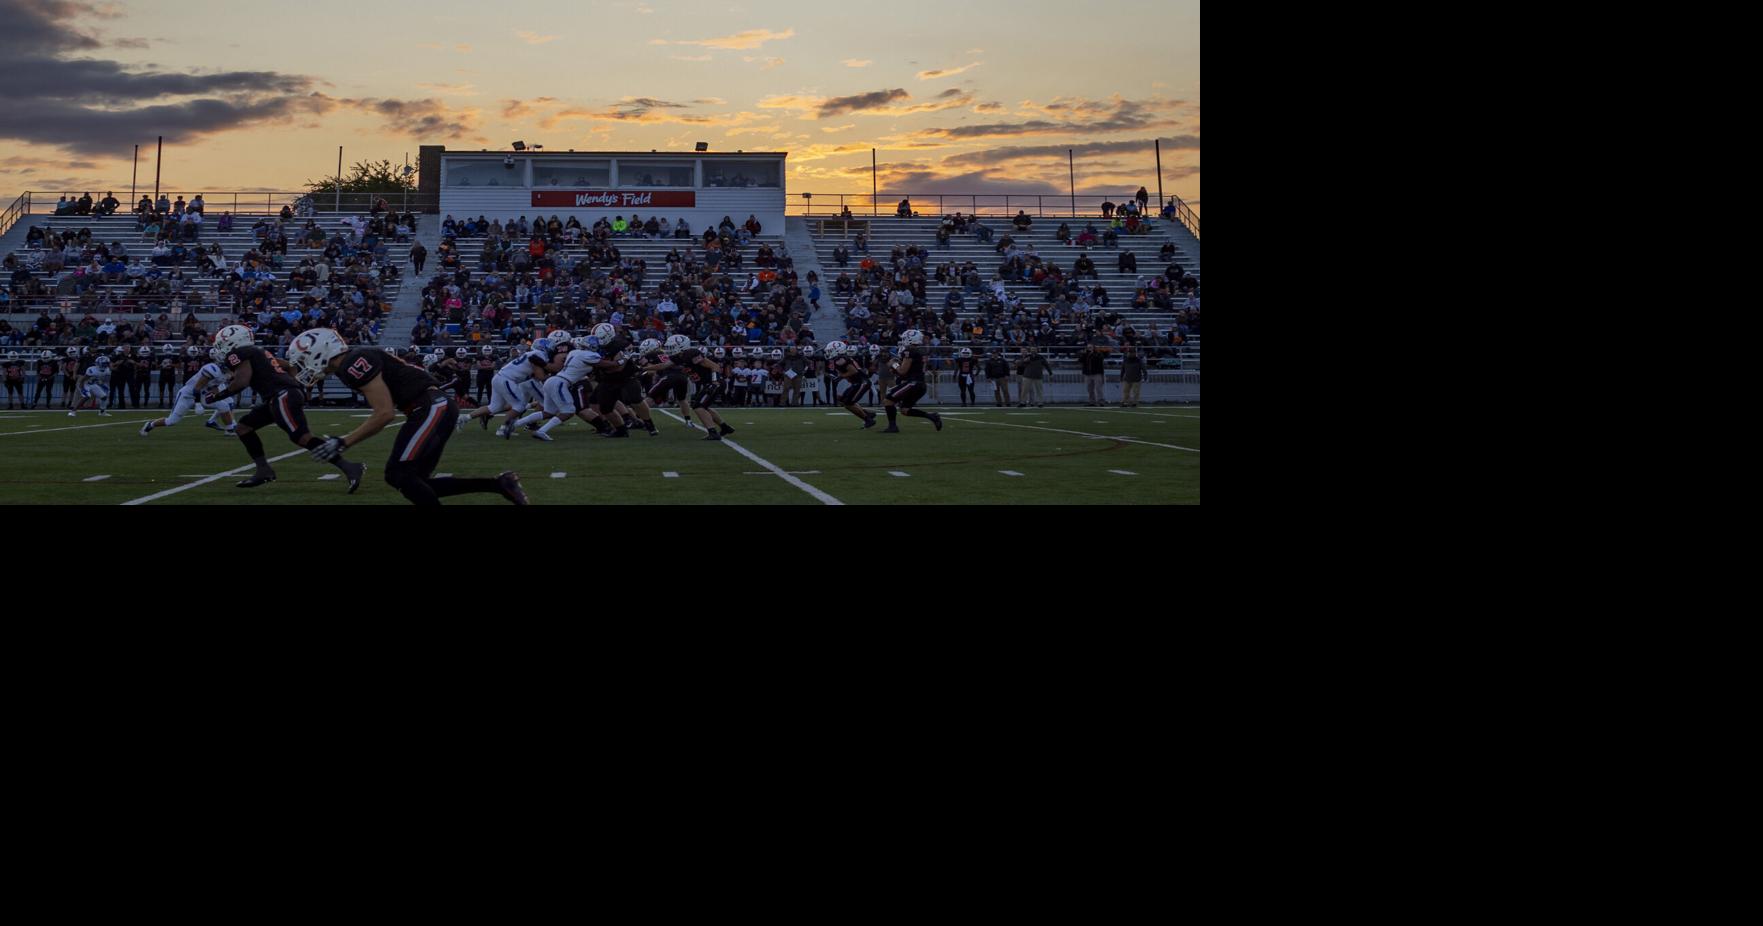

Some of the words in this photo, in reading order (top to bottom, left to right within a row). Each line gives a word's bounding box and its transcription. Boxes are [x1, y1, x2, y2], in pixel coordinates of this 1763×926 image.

[575, 191, 619, 207] Wendy's
[622, 192, 652, 206] Field
[347, 356, 373, 379] 17
